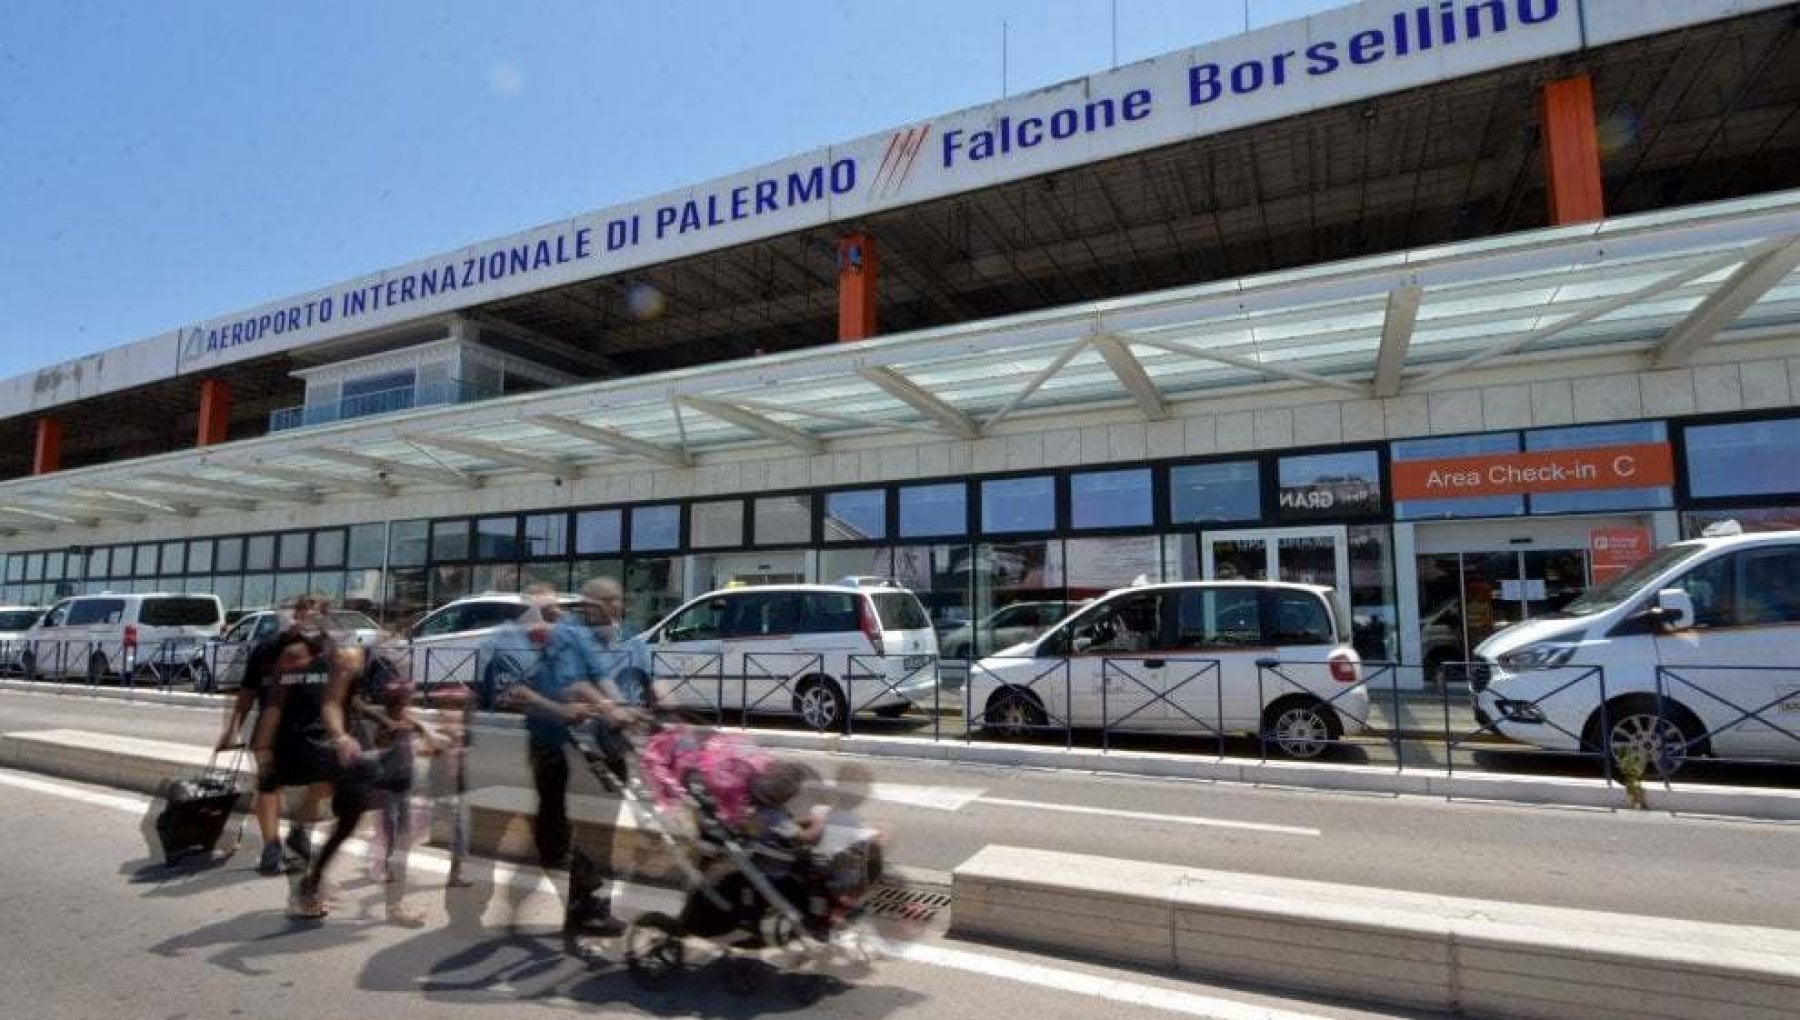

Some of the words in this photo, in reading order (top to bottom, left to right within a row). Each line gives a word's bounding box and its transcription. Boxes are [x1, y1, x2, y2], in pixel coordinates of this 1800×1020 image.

[206, 297, 332, 352] AEROPORTO
[342, 228, 591, 317] INTERNAZIONALE
[607, 214, 640, 251] DI
[656, 158, 856, 239] PALERMO
[943, 87, 1151, 168] Falcone
[1189, 0, 1559, 107] Borsellino
[1426, 470, 1481, 488] Area
[1488, 461, 1595, 485] Check-in
[1613, 455, 1636, 476] C
